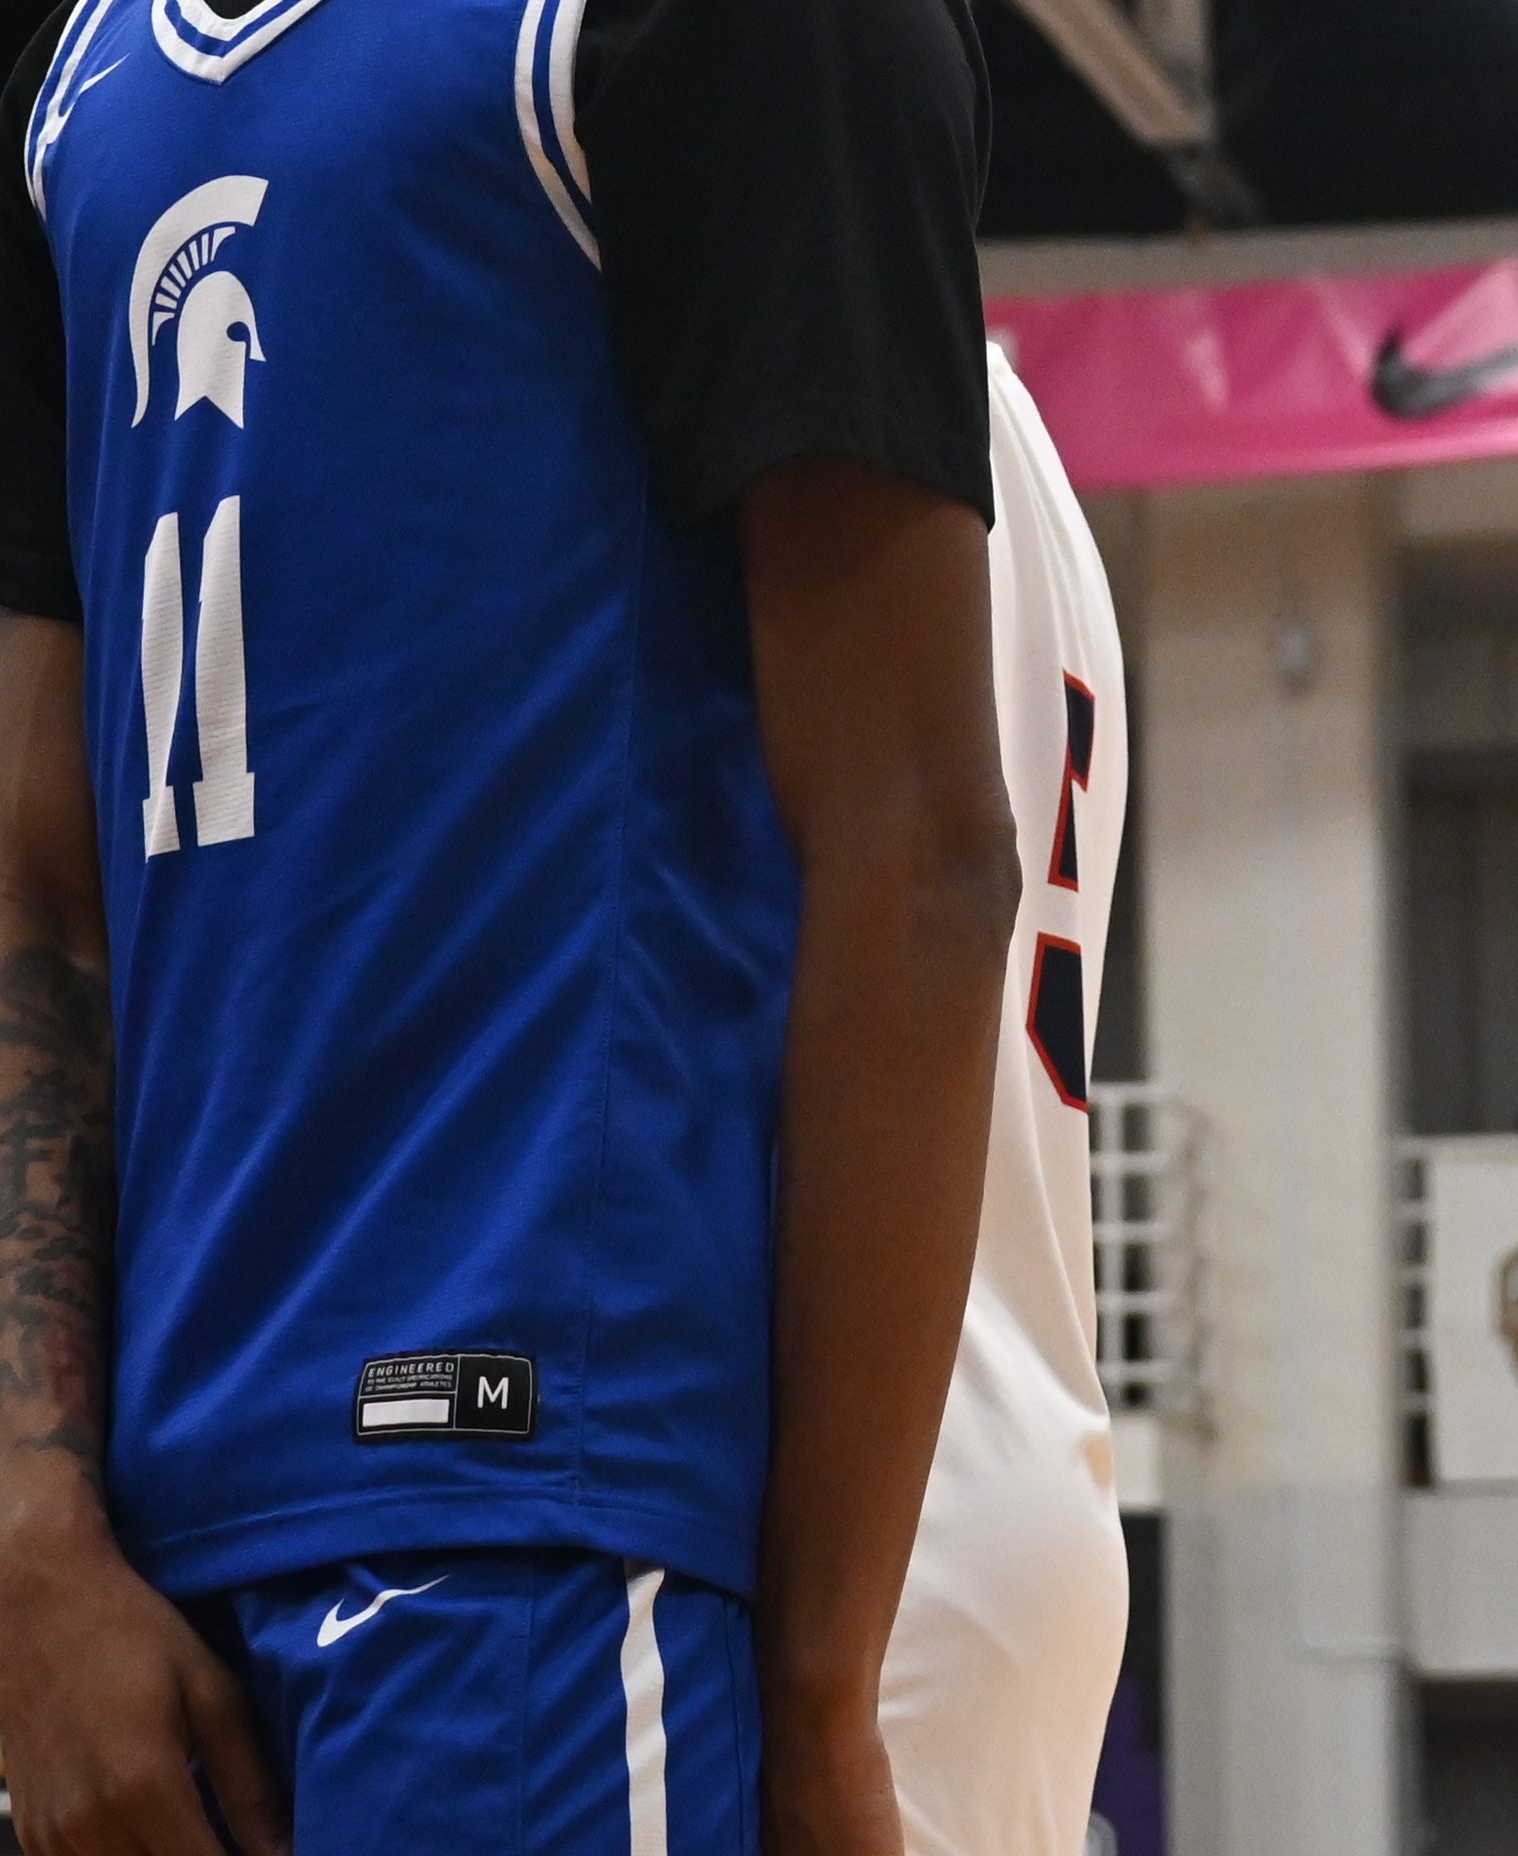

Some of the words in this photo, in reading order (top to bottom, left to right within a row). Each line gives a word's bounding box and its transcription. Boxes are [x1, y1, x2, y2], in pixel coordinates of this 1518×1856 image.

[141, 494, 256, 865] 11
[367, 1361, 455, 1379] ENGINEERED
[476, 1375, 510, 1410] M
